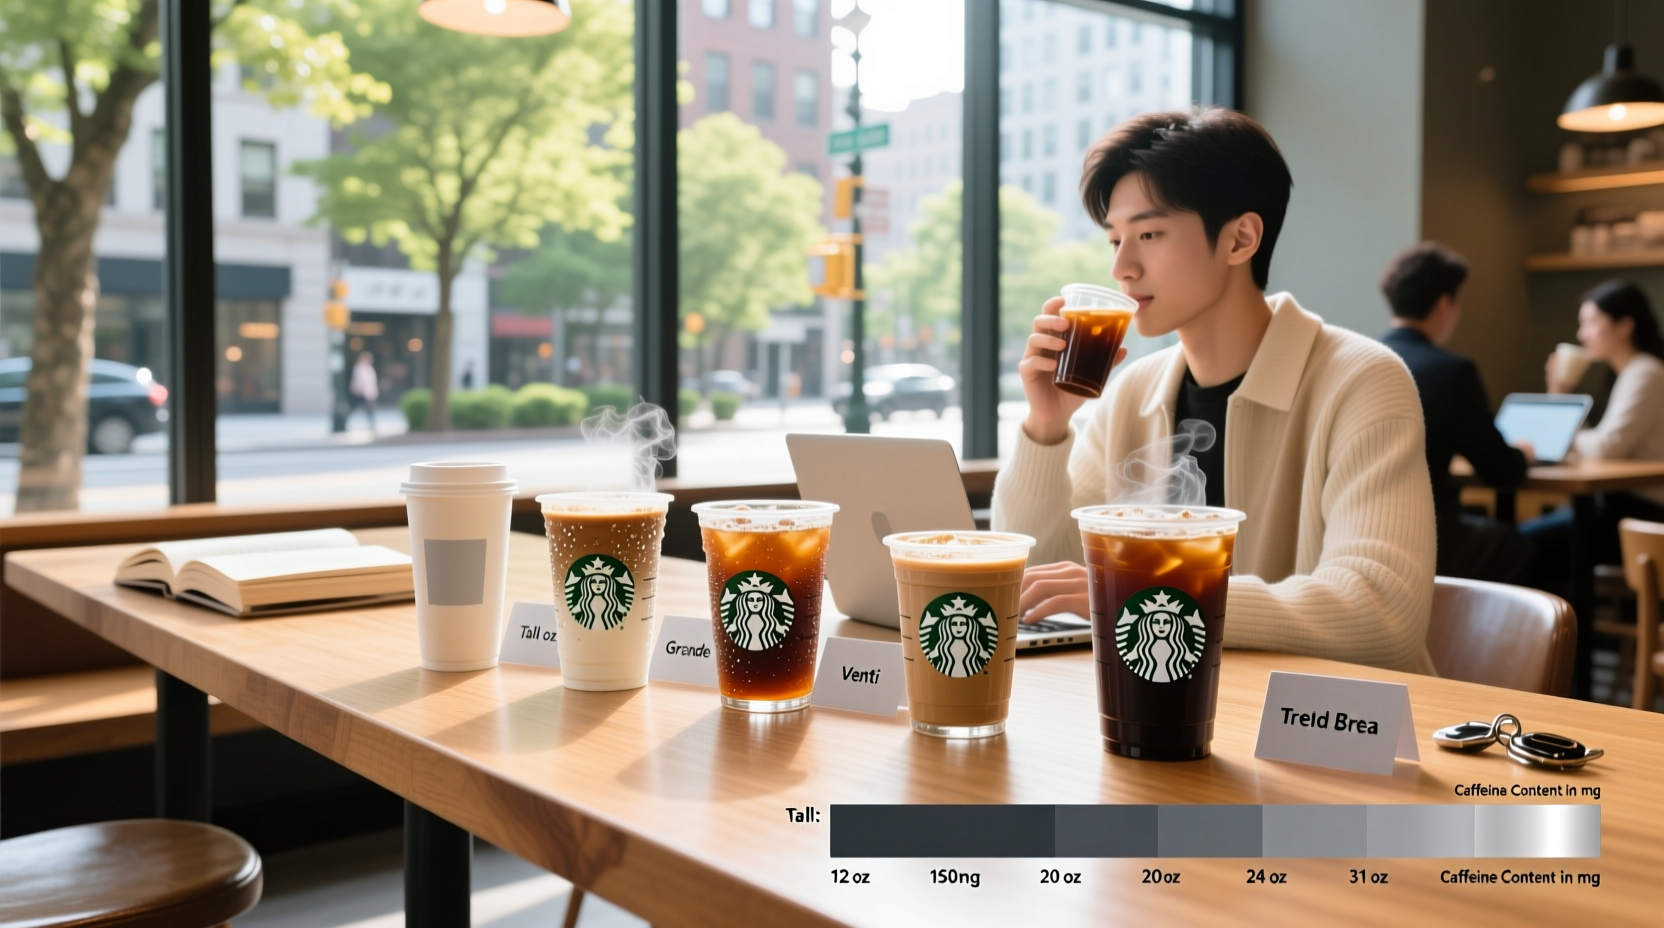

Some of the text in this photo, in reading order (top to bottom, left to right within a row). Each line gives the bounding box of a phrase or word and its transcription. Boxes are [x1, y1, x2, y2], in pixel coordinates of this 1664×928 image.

[520, 625, 540, 640] Tall
[842, 665, 881, 684] Venti
[1334, 712, 1379, 735] Brea
